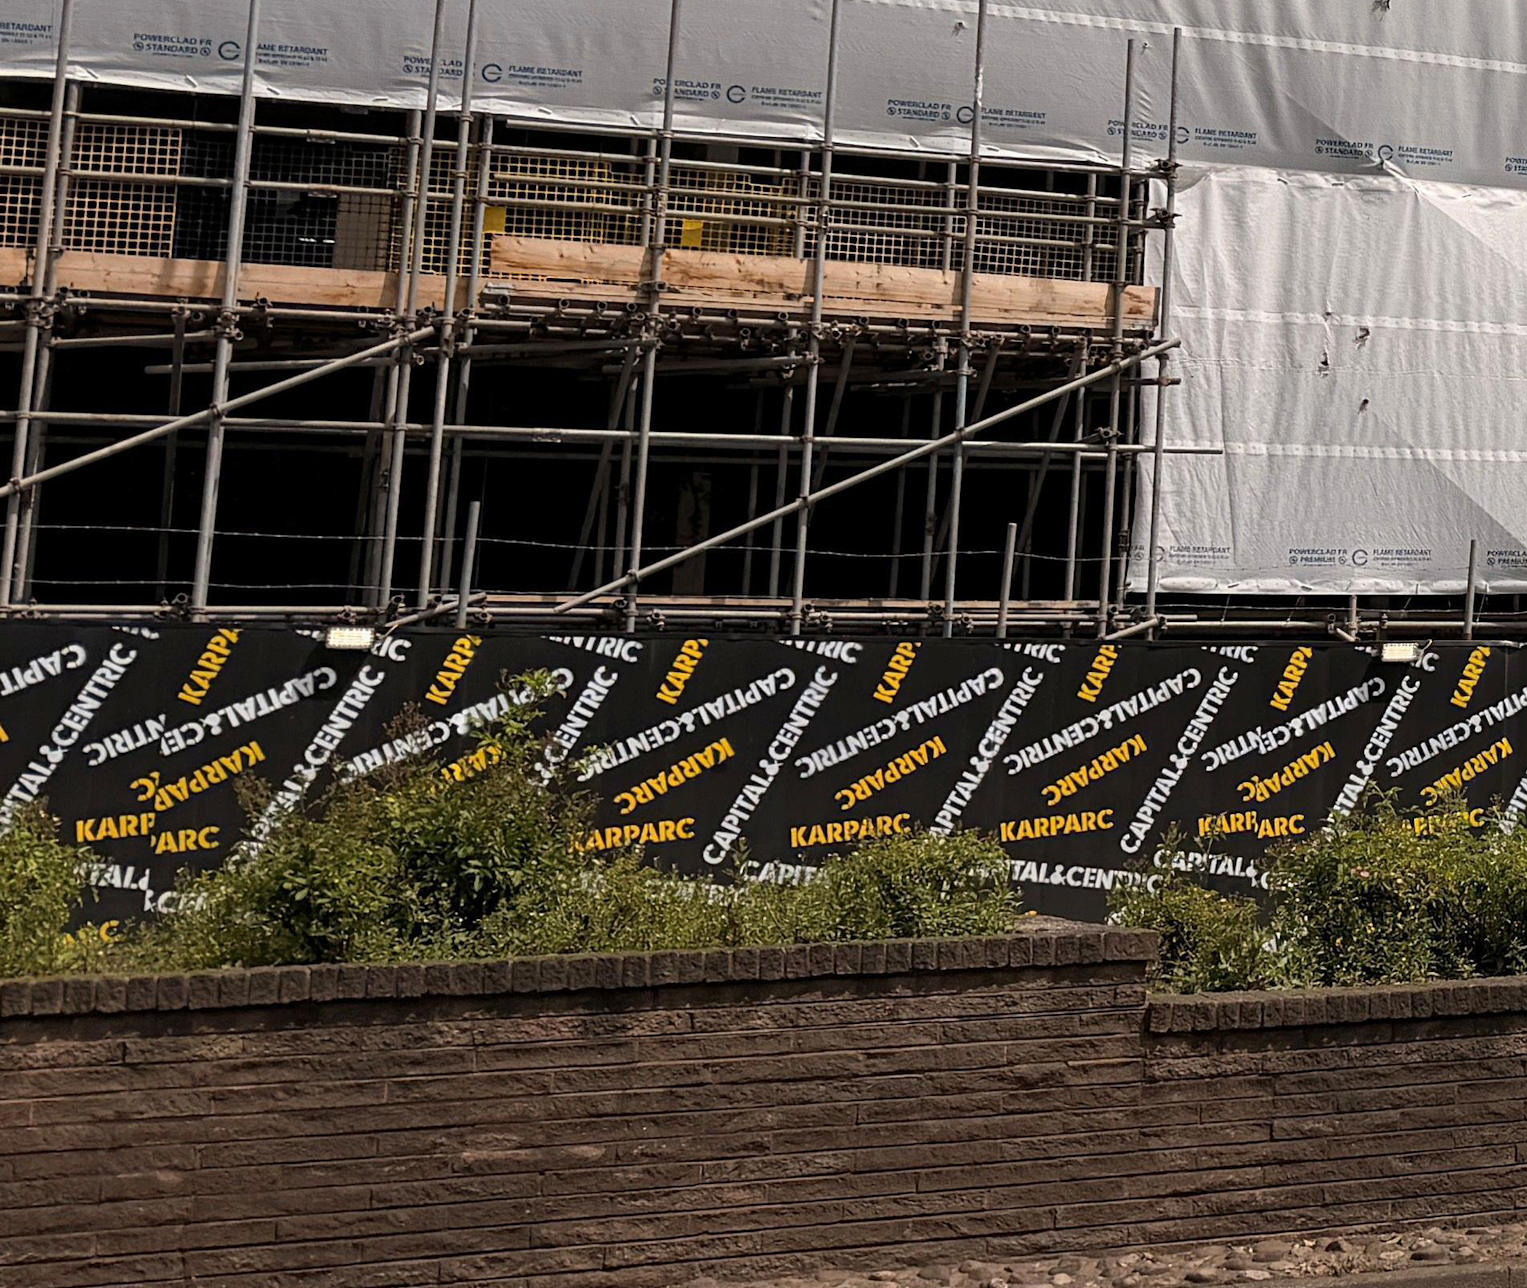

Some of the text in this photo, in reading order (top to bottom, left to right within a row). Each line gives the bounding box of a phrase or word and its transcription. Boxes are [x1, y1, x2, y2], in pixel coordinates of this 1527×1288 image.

[134, 33, 197, 45] POWERCLAD
[146, 43, 198, 53] STANDARD
[278, 44, 328, 56] RETARDANT
[656, 639, 709, 705] KARP
[794, 667, 1005, 779] CAPITAL&CENTRIC
[928, 666, 1045, 837] APITAL&CENTRIC
[1006, 668, 1201, 775] CAPITAL&CENTRIC
[613, 737, 735, 815] KARPARC
[702, 665, 838, 864] CAPITAL&CENTRIC
[834, 735, 948, 811] KARPARC
[1041, 733, 1147, 806] KARPARC
[1120, 666, 1239, 854] CAPITAL&CENTRIC
[1000, 809, 1113, 842] KARPARC
